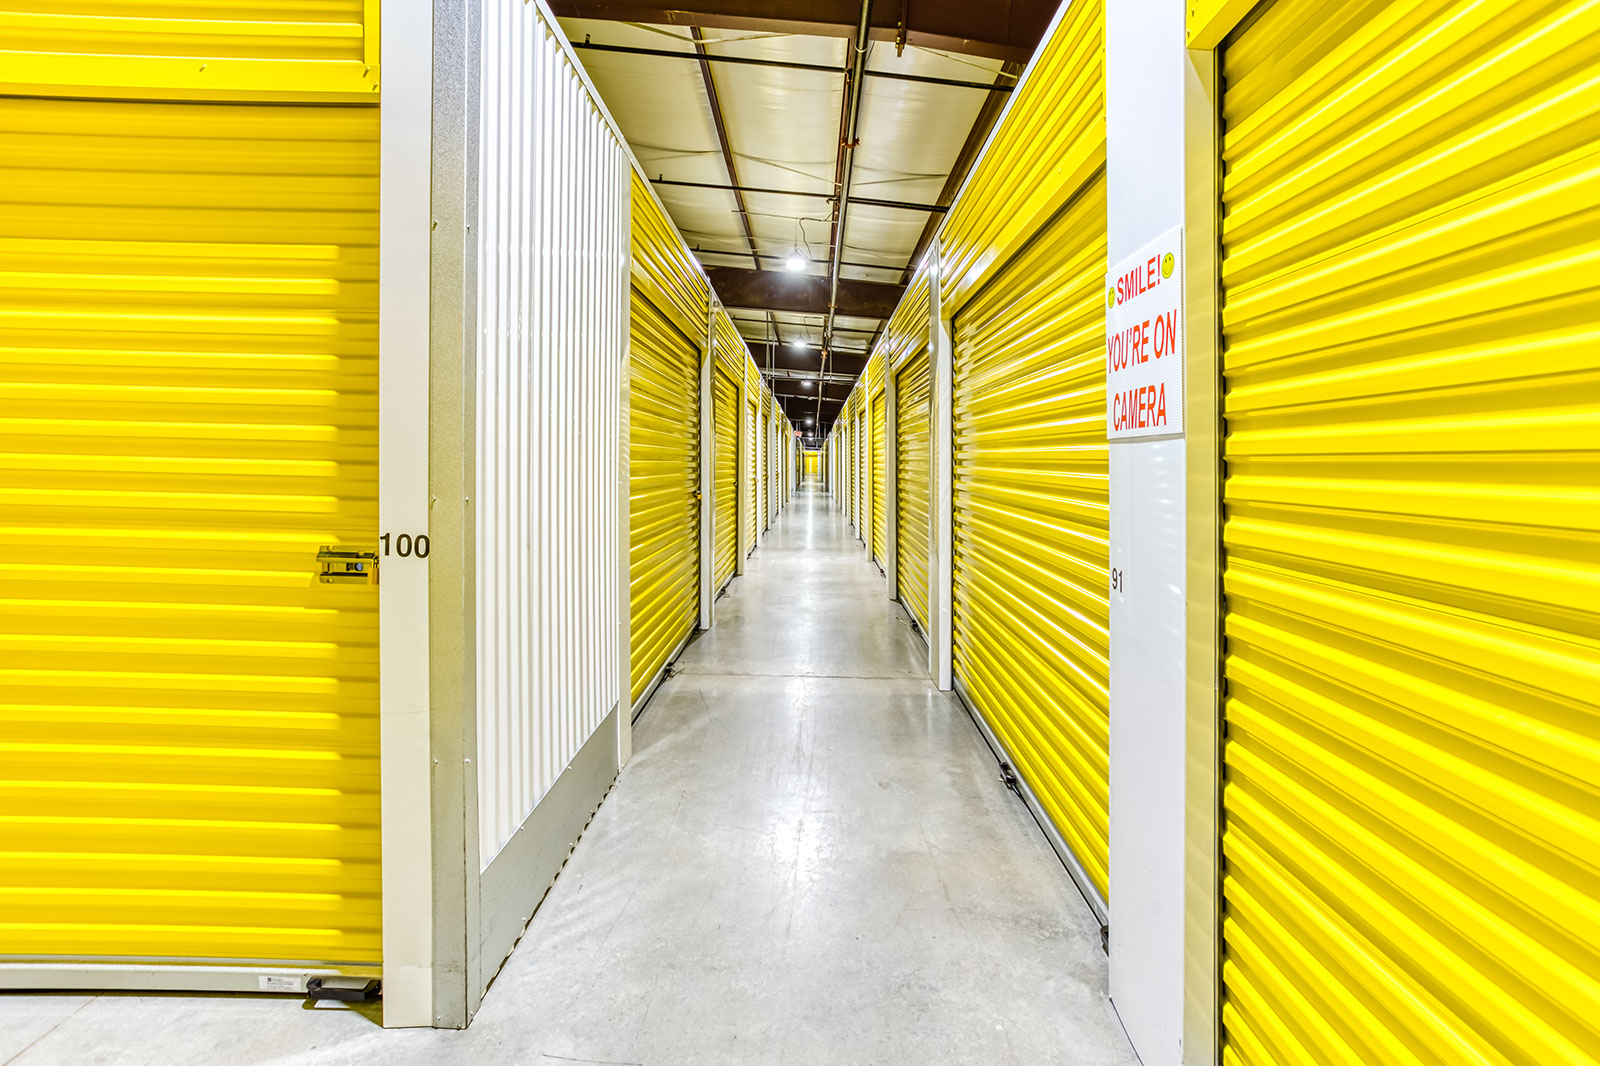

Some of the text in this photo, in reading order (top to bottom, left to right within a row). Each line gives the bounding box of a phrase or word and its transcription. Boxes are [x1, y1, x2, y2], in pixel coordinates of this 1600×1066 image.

[1117, 254, 1160, 305] SMILE!
[1108, 309, 1177, 374] YOU'RE ON
[1113, 383, 1167, 431] CAMERA
[380, 533, 430, 558] 100
[1112, 567, 1122, 593] 91
